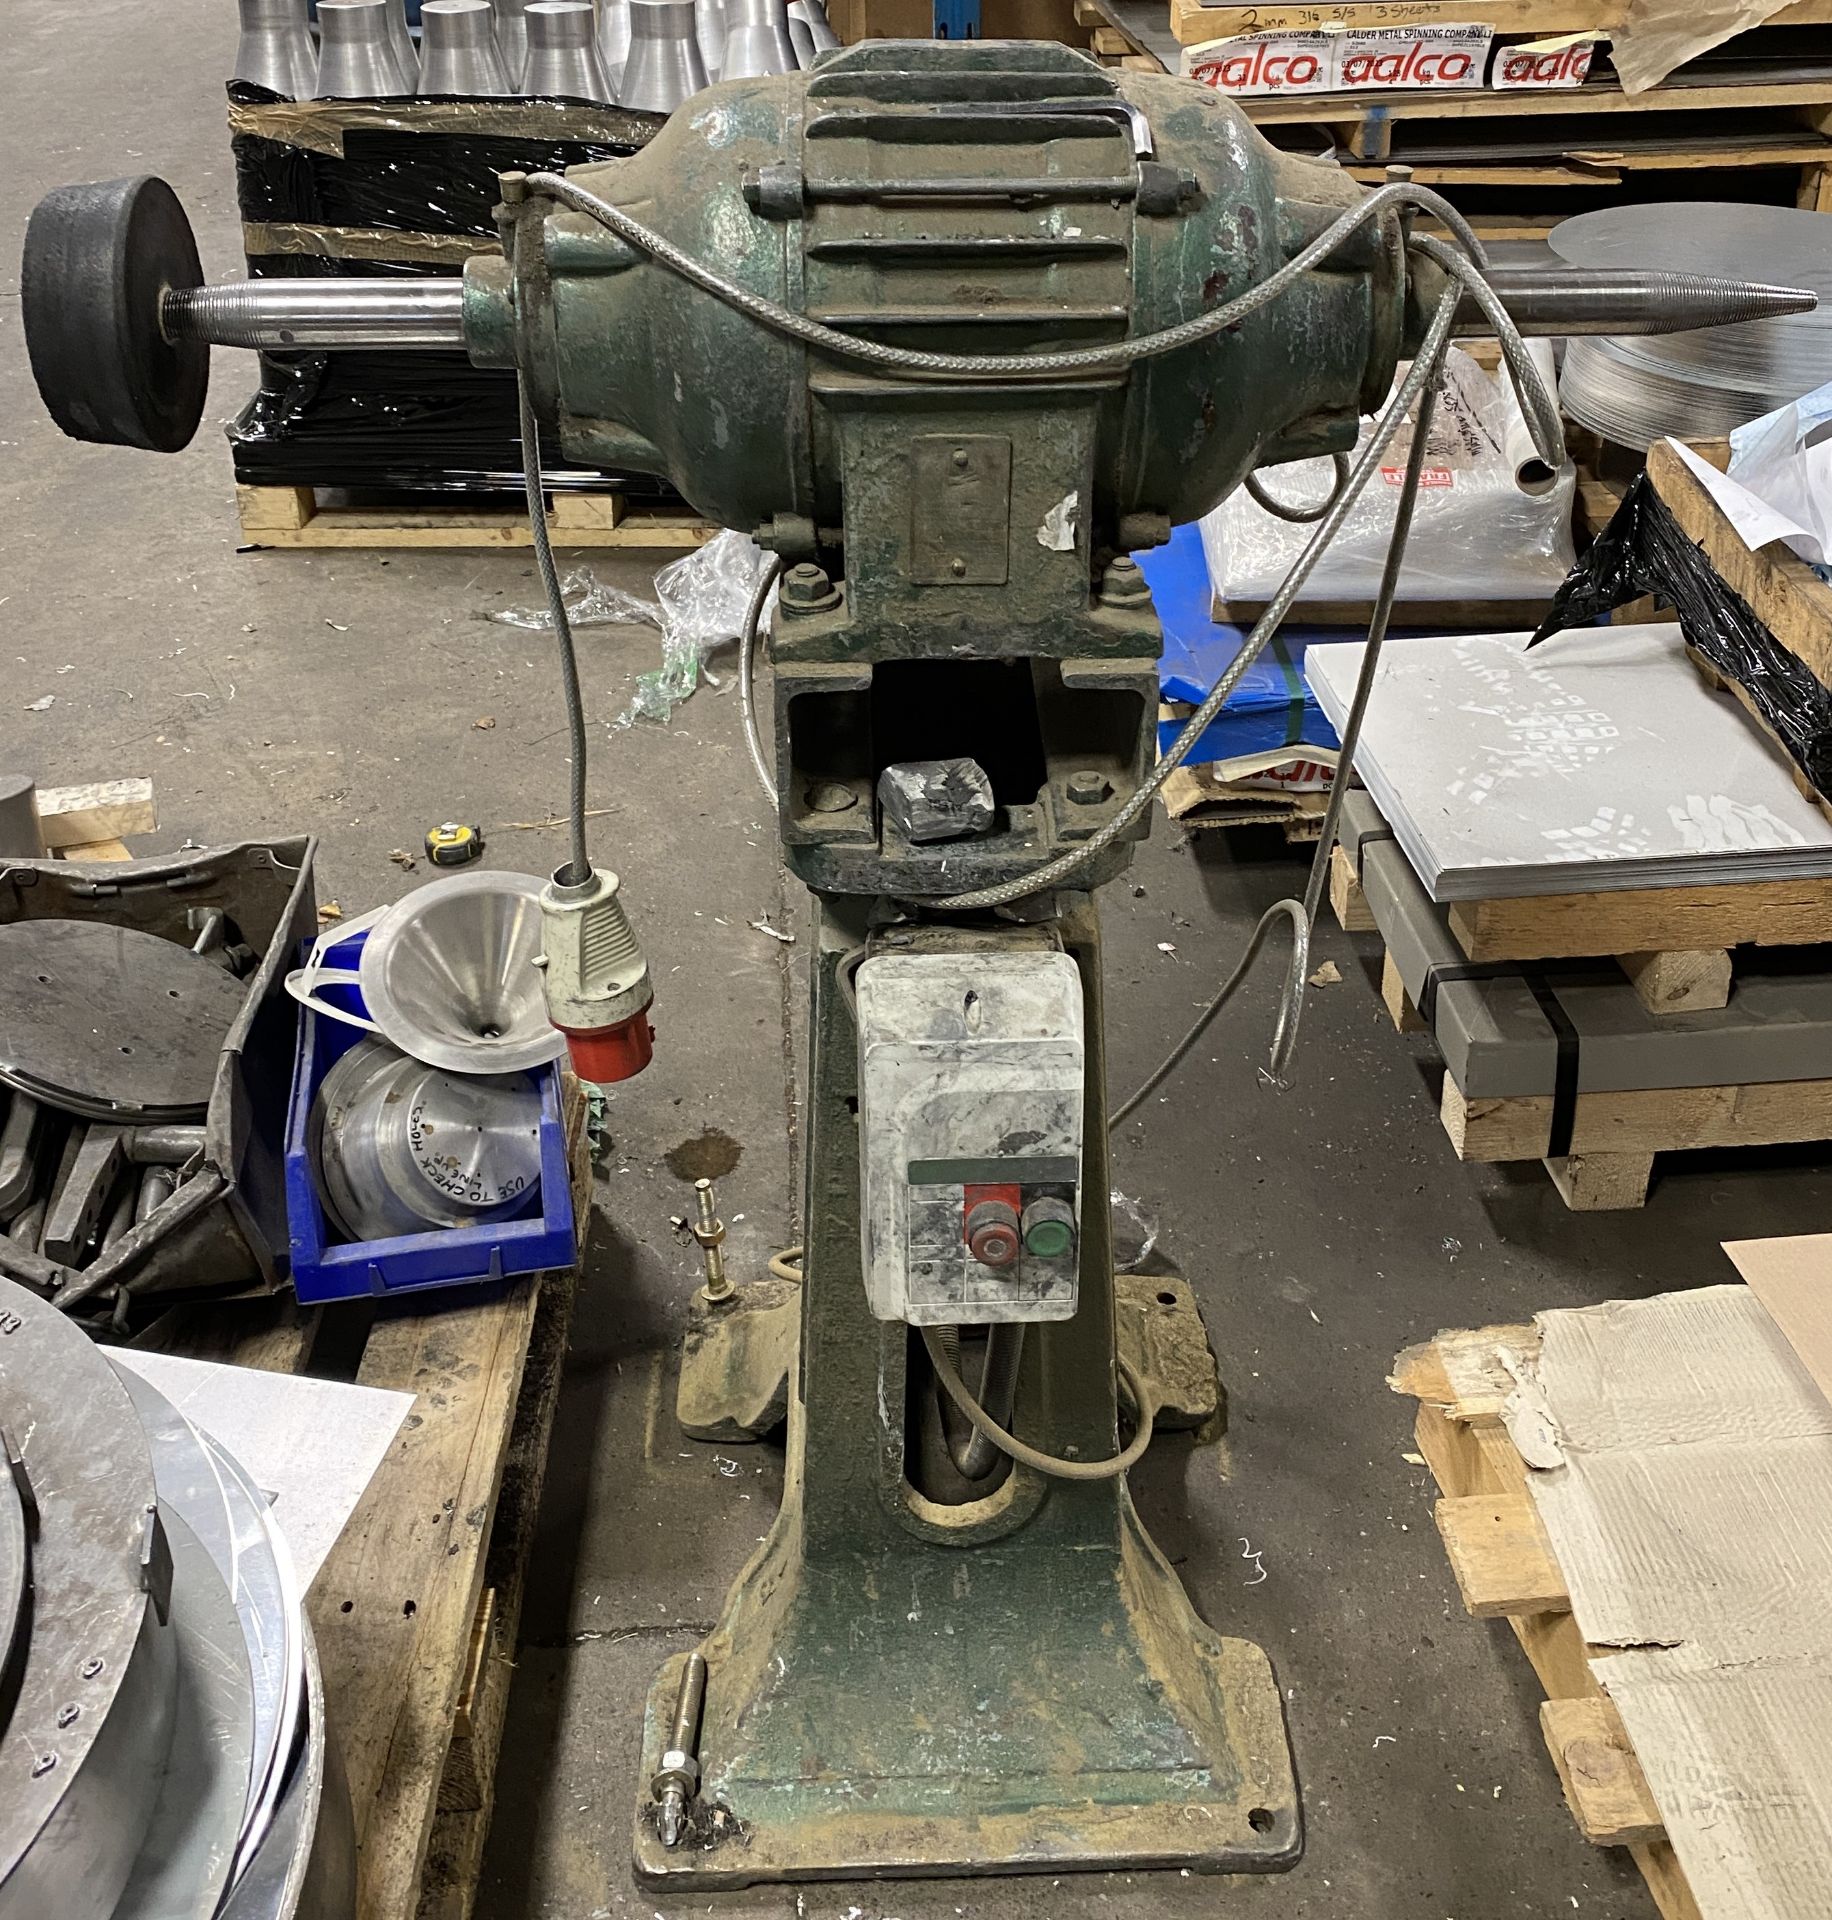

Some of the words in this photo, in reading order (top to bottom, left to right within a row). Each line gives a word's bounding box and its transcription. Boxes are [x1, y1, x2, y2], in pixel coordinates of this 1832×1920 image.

[1249, 32, 1288, 41] SPINNING
[1346, 30, 1376, 39] CALDER
[1378, 29, 1402, 40] METAL
[1404, 29, 1444, 39] SPINNING
[1191, 42, 1318, 87] aalco
[1343, 40, 1472, 84] aalco
[1388, 473, 1447, 481] FRALE
[419, 1156, 465, 1197] CHECK
[451, 1170, 482, 1189] LINE
[498, 1176, 524, 1199] USE
[469, 1192, 493, 1203] TO
